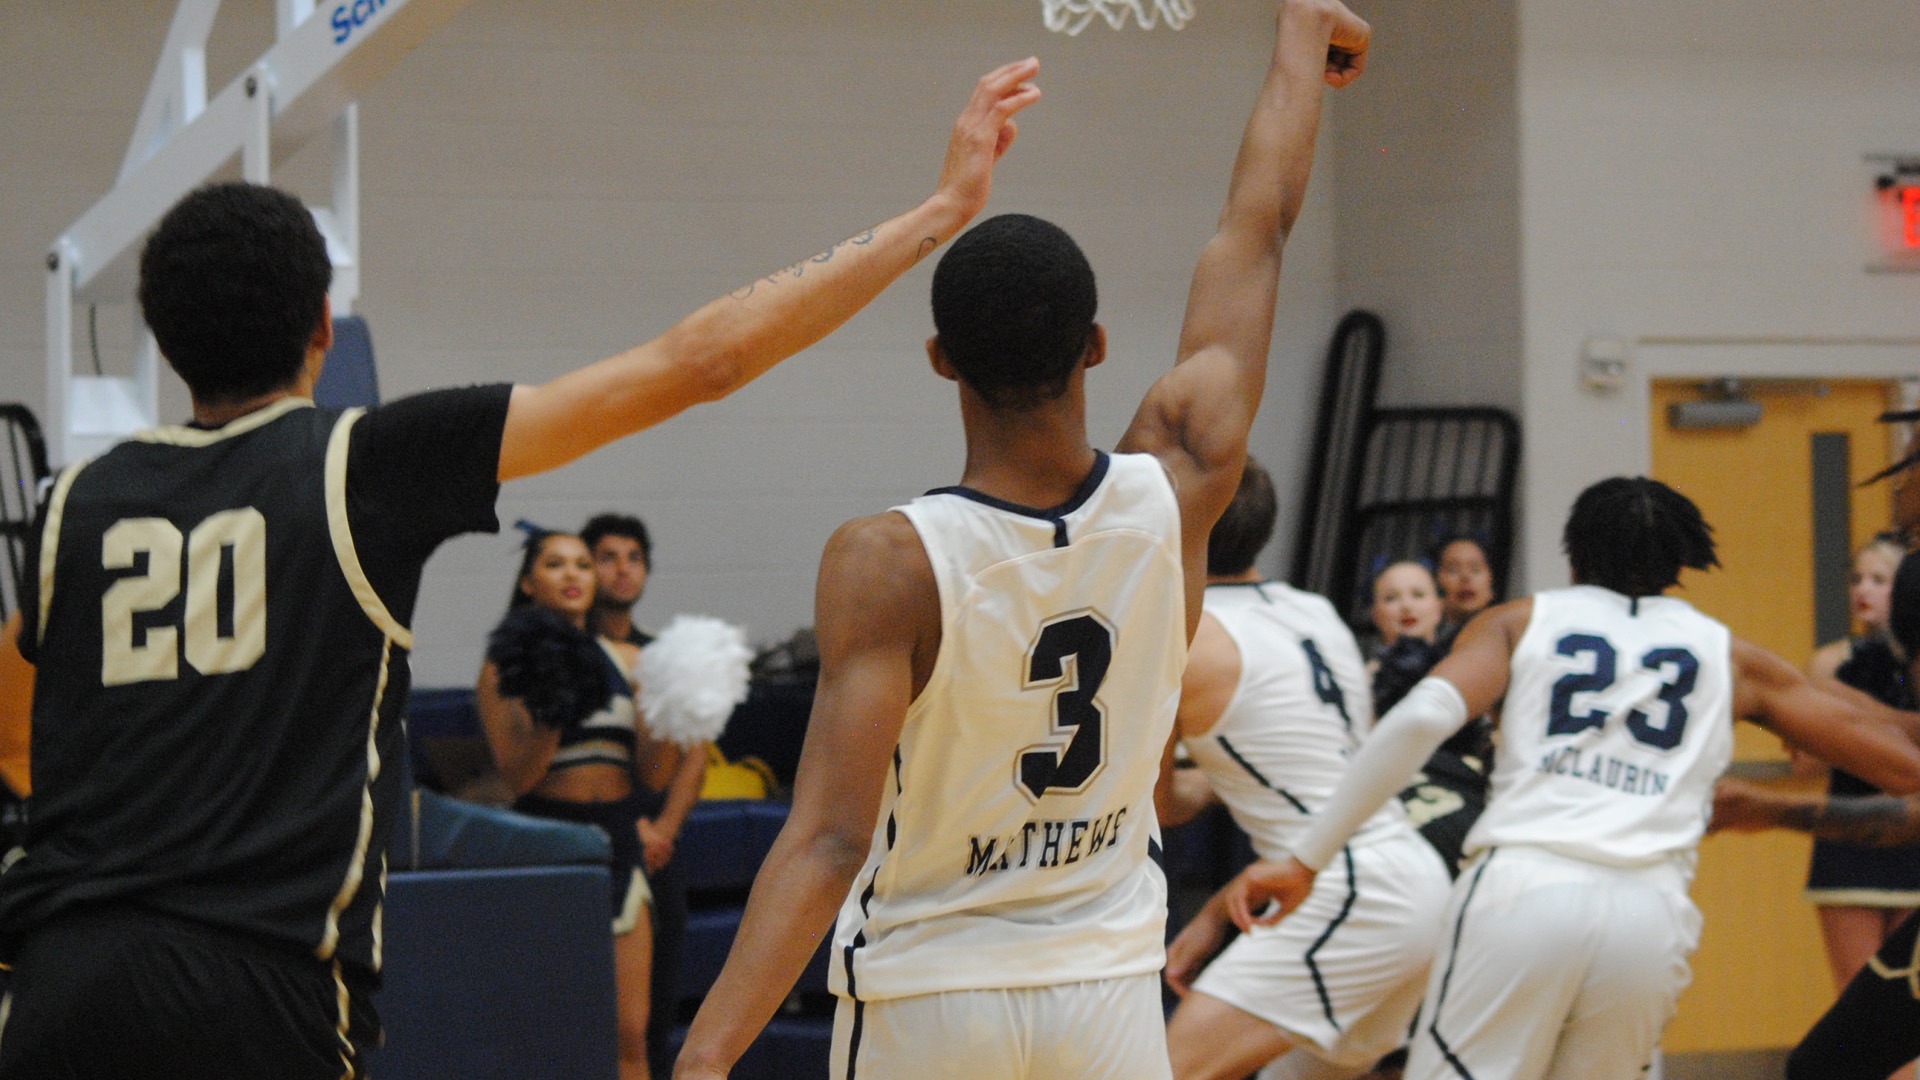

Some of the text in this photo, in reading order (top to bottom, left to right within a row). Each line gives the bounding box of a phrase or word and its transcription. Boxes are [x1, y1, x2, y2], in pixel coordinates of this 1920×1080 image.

[102, 505, 266, 688] 20
[1014, 607, 1118, 804] 3
[1301, 638, 1351, 724] 4
[1547, 633, 1699, 750] 23
